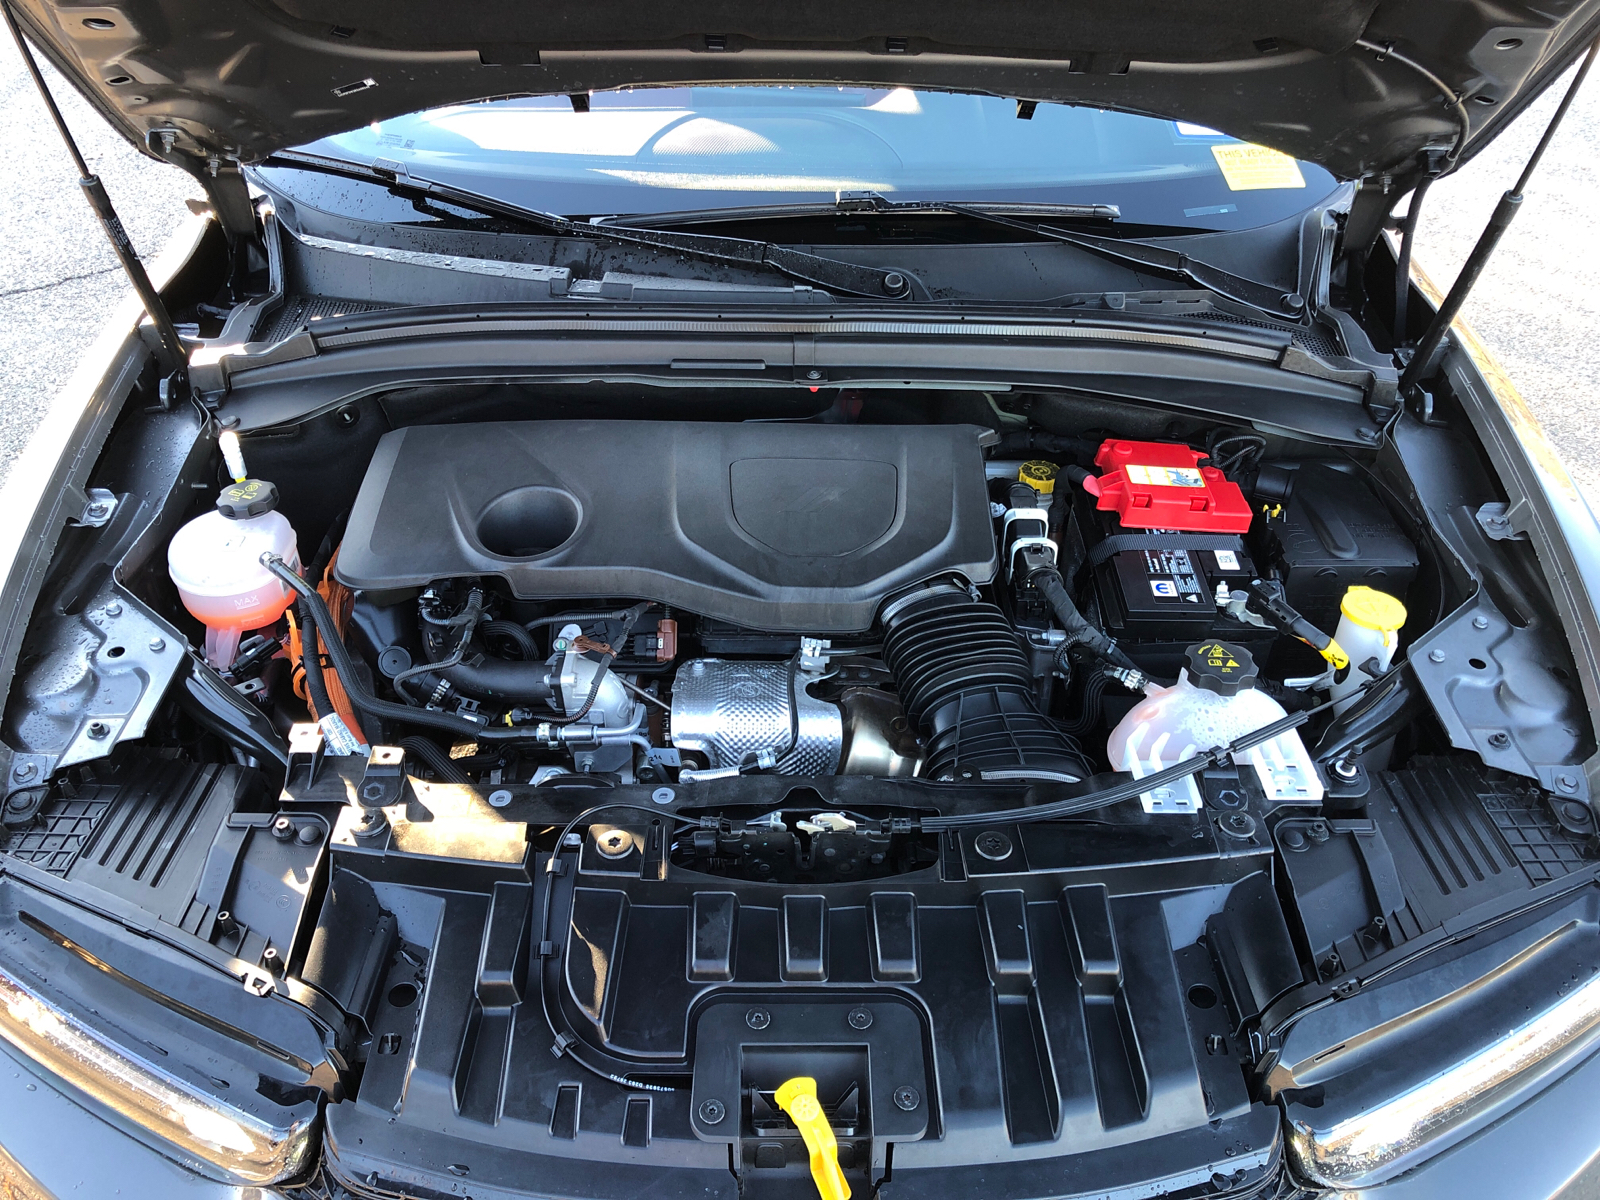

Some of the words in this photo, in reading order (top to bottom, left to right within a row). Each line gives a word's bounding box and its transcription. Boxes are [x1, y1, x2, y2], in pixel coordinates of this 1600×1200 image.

[1216, 149, 1242, 159] THIS
[1244, 148, 1285, 158] VEHIC
[234, 595, 259, 606] MAX
